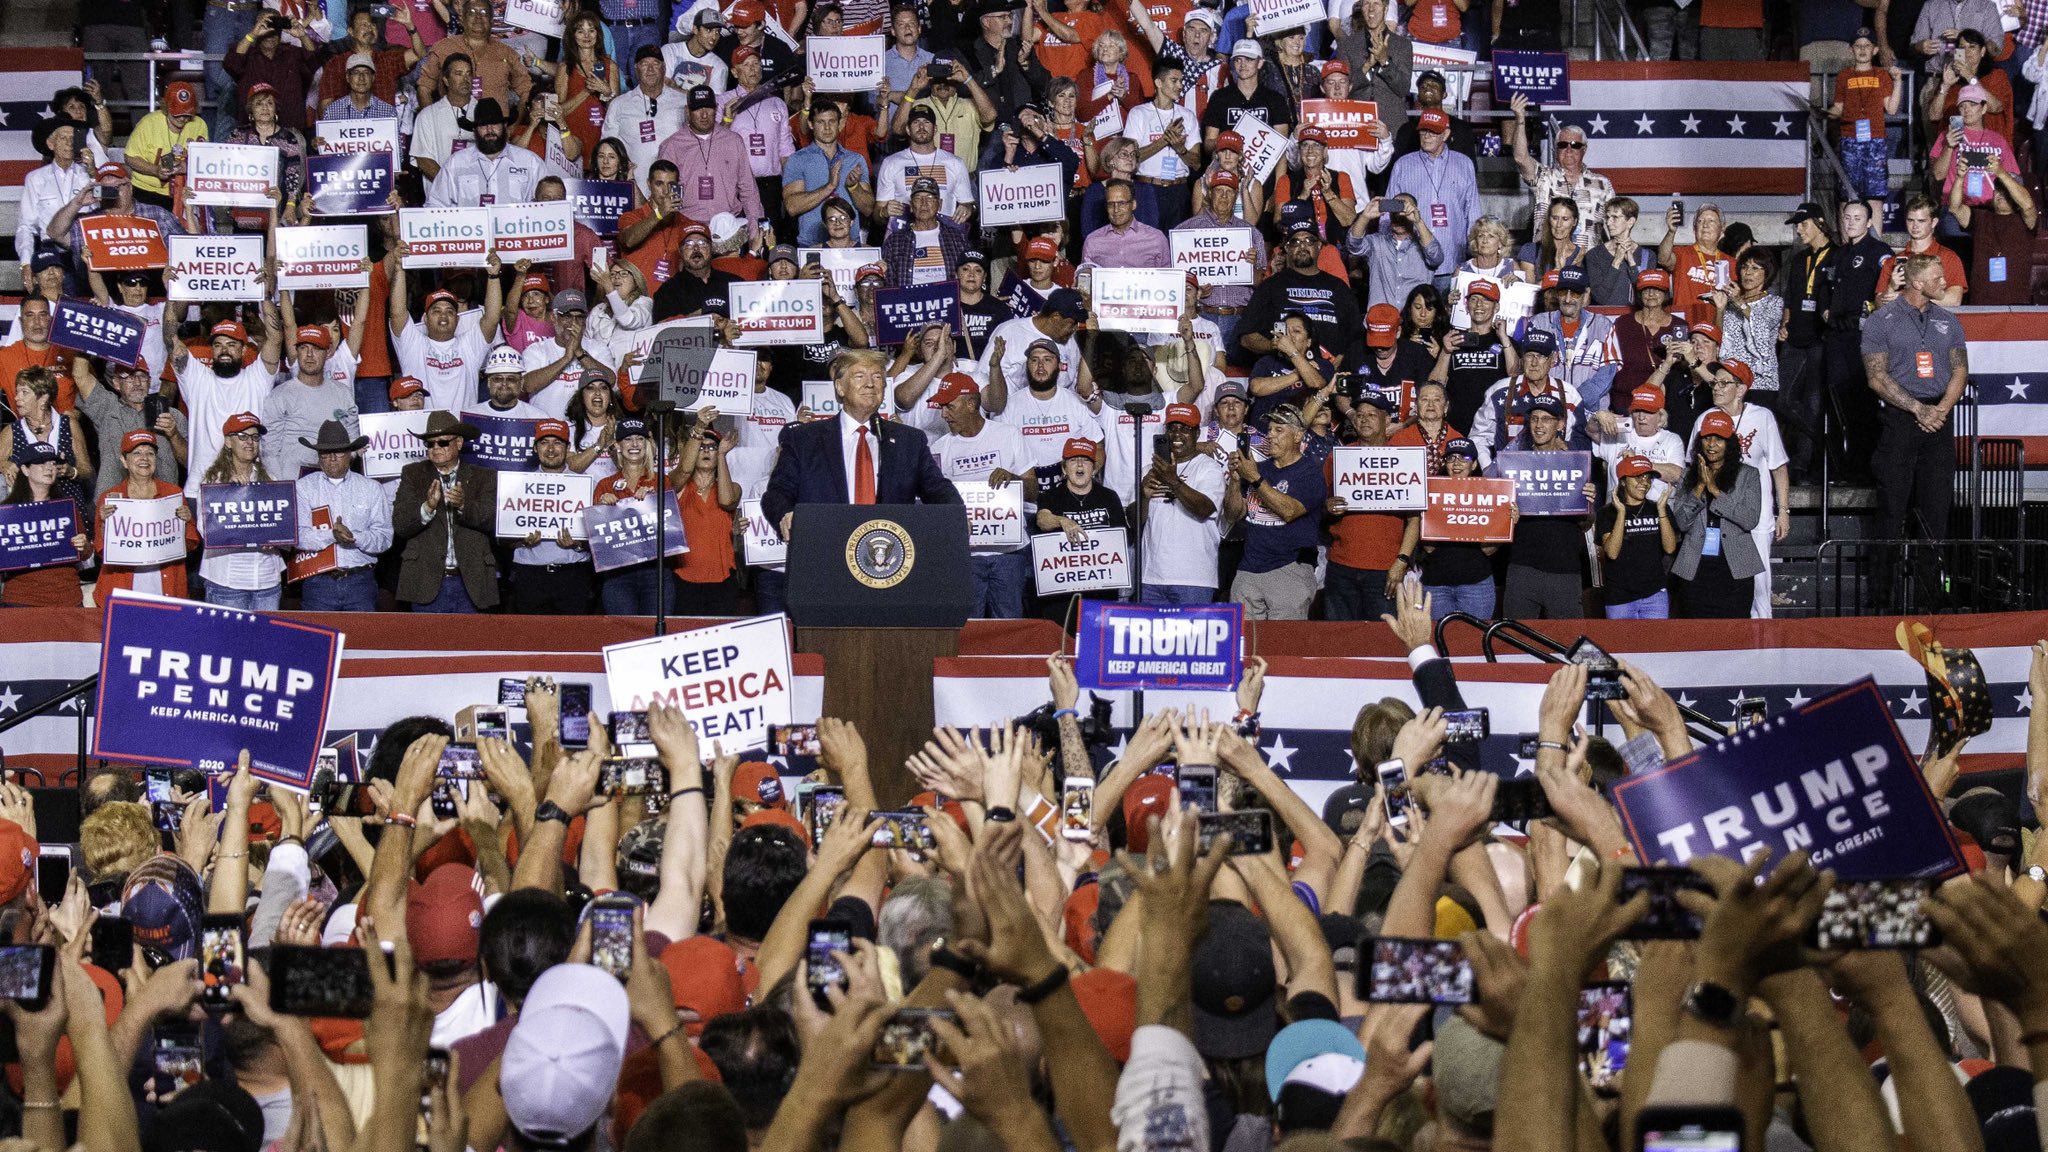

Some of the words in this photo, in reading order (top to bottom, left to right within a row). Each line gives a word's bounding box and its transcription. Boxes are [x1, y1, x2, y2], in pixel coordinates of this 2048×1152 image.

[1262, 11, 1280, 21] FOR
[1282, 3, 1311, 18] TRUMP
[812, 51, 879, 69] Women
[820, 70, 843, 78] FOR
[847, 69, 873, 77] TRUMP
[1498, 65, 1563, 77] TRUMP
[1306, 111, 1374, 124] TRUMP
[340, 128, 374, 138] KEEP
[1324, 128, 1358, 138] 2020
[324, 140, 394, 152] AMERICA
[195, 156, 269, 179] Latinos
[313, 169, 386, 182] TRUMP
[198, 181, 221, 191] FOR
[223, 180, 266, 192] TRUMP
[986, 182, 1056, 202] Women
[566, 195, 628, 206] TRUMP
[994, 202, 1014, 210] FOR
[1018, 199, 1050, 209] TRUMP
[573, 206, 623, 214] PENCE
[88, 227, 159, 239] TRUMP
[408, 221, 483, 239] Latinos
[494, 217, 566, 236] Latinos
[412, 243, 438, 253] FOR
[441, 241, 482, 252] TRUMP
[498, 239, 522, 249] FOR
[525, 236, 564, 248] TRUMP
[1194, 238, 1229, 248] KEEP
[109, 244, 148, 256] 2020
[196, 246, 236, 258] KEEP
[285, 241, 359, 258] Latinos
[1177, 251, 1246, 262] AMERICA
[176, 261, 258, 275] AMERICA
[288, 262, 308, 273] FOR
[311, 262, 358, 273] TRUMP
[1189, 265, 1238, 277] GREAT!
[188, 278, 246, 291] GREAT!
[1101, 282, 1176, 302] Latinos
[1286, 288, 1333, 298] TRUMP
[882, 298, 953, 315] TRUMP
[1103, 307, 1129, 317] FOR
[1133, 307, 1174, 317] TRUMP
[62, 308, 138, 338] TRUMP
[742, 318, 768, 329] FOR
[771, 317, 812, 328] TRUMP
[889, 311, 948, 323] PENCE
[66, 321, 130, 345] PENCE
[636, 333, 705, 355] Women
[642, 357, 661, 365] FOR
[668, 362, 747, 388] Women
[676, 386, 697, 395] FOR
[702, 388, 739, 398] TRUMP
[1022, 412, 1068, 425] Latinos
[1136, 414, 1160, 422] TUMP
[1024, 426, 1039, 434] FOR
[1042, 424, 1069, 434] TRUMP
[480, 433, 534, 447] RUM
[378, 451, 399, 460] FOR
[473, 444, 533, 456] PENCE
[955, 452, 996, 466] TRUMP
[959, 461, 995, 470] PENCE
[1359, 458, 1399, 468] KEEP
[1339, 472, 1421, 486] AMERICA
[1505, 469, 1582, 481] TRUMP
[525, 482, 566, 496] KEEP
[1515, 482, 1576, 491] PENCE
[1352, 489, 1410, 501] GREAT!
[1429, 492, 1509, 506] TRUMP
[210, 499, 289, 514] TRUMP
[503, 498, 586, 513] AMERICA
[218, 512, 282, 522] PENCE
[515, 515, 574, 529] GREAT!
[594, 508, 672, 536] TRUMP
[1066, 511, 1106, 522] TRUMP
[1446, 514, 1489, 525] 2020
[0, 517, 71, 536] TRUMP
[112, 516, 181, 538] Women
[1, 531, 65, 544] PENCE
[120, 538, 142, 548] FOR
[147, 536, 176, 547] TRUMP
[626, 538, 647, 546] AMERICA
[761, 538, 785, 547] FOR
[849, 522, 879, 550] PRESIDENT
[899, 531, 912, 559] UNITED
[1059, 539, 1099, 552] KEEP
[1040, 552, 1123, 571] AMERICA
[857, 572, 873, 584] SEAL
[886, 565, 909, 585] STATES
[1054, 569, 1112, 583] GREAT!
[1109, 615, 1229, 656] TRUMP
[661, 645, 740, 679] KEEP
[1108, 660, 1135, 675] KEEP
[1137, 661, 1187, 675] AMERICA
[1190, 661, 1226, 676] GREAT
[122, 646, 314, 696] TRUMP
[138, 681, 295, 718] PENCE
[151, 706, 181, 718] KEEP
[184, 709, 237, 724] AMERICA
[240, 716, 279, 731] GREAT!
[199, 760, 225, 769] 2020
[758, 781, 779, 791] TRUMP
[1658, 744, 1890, 863] TRUMP
[1836, 825, 1884, 853] GREAT!
